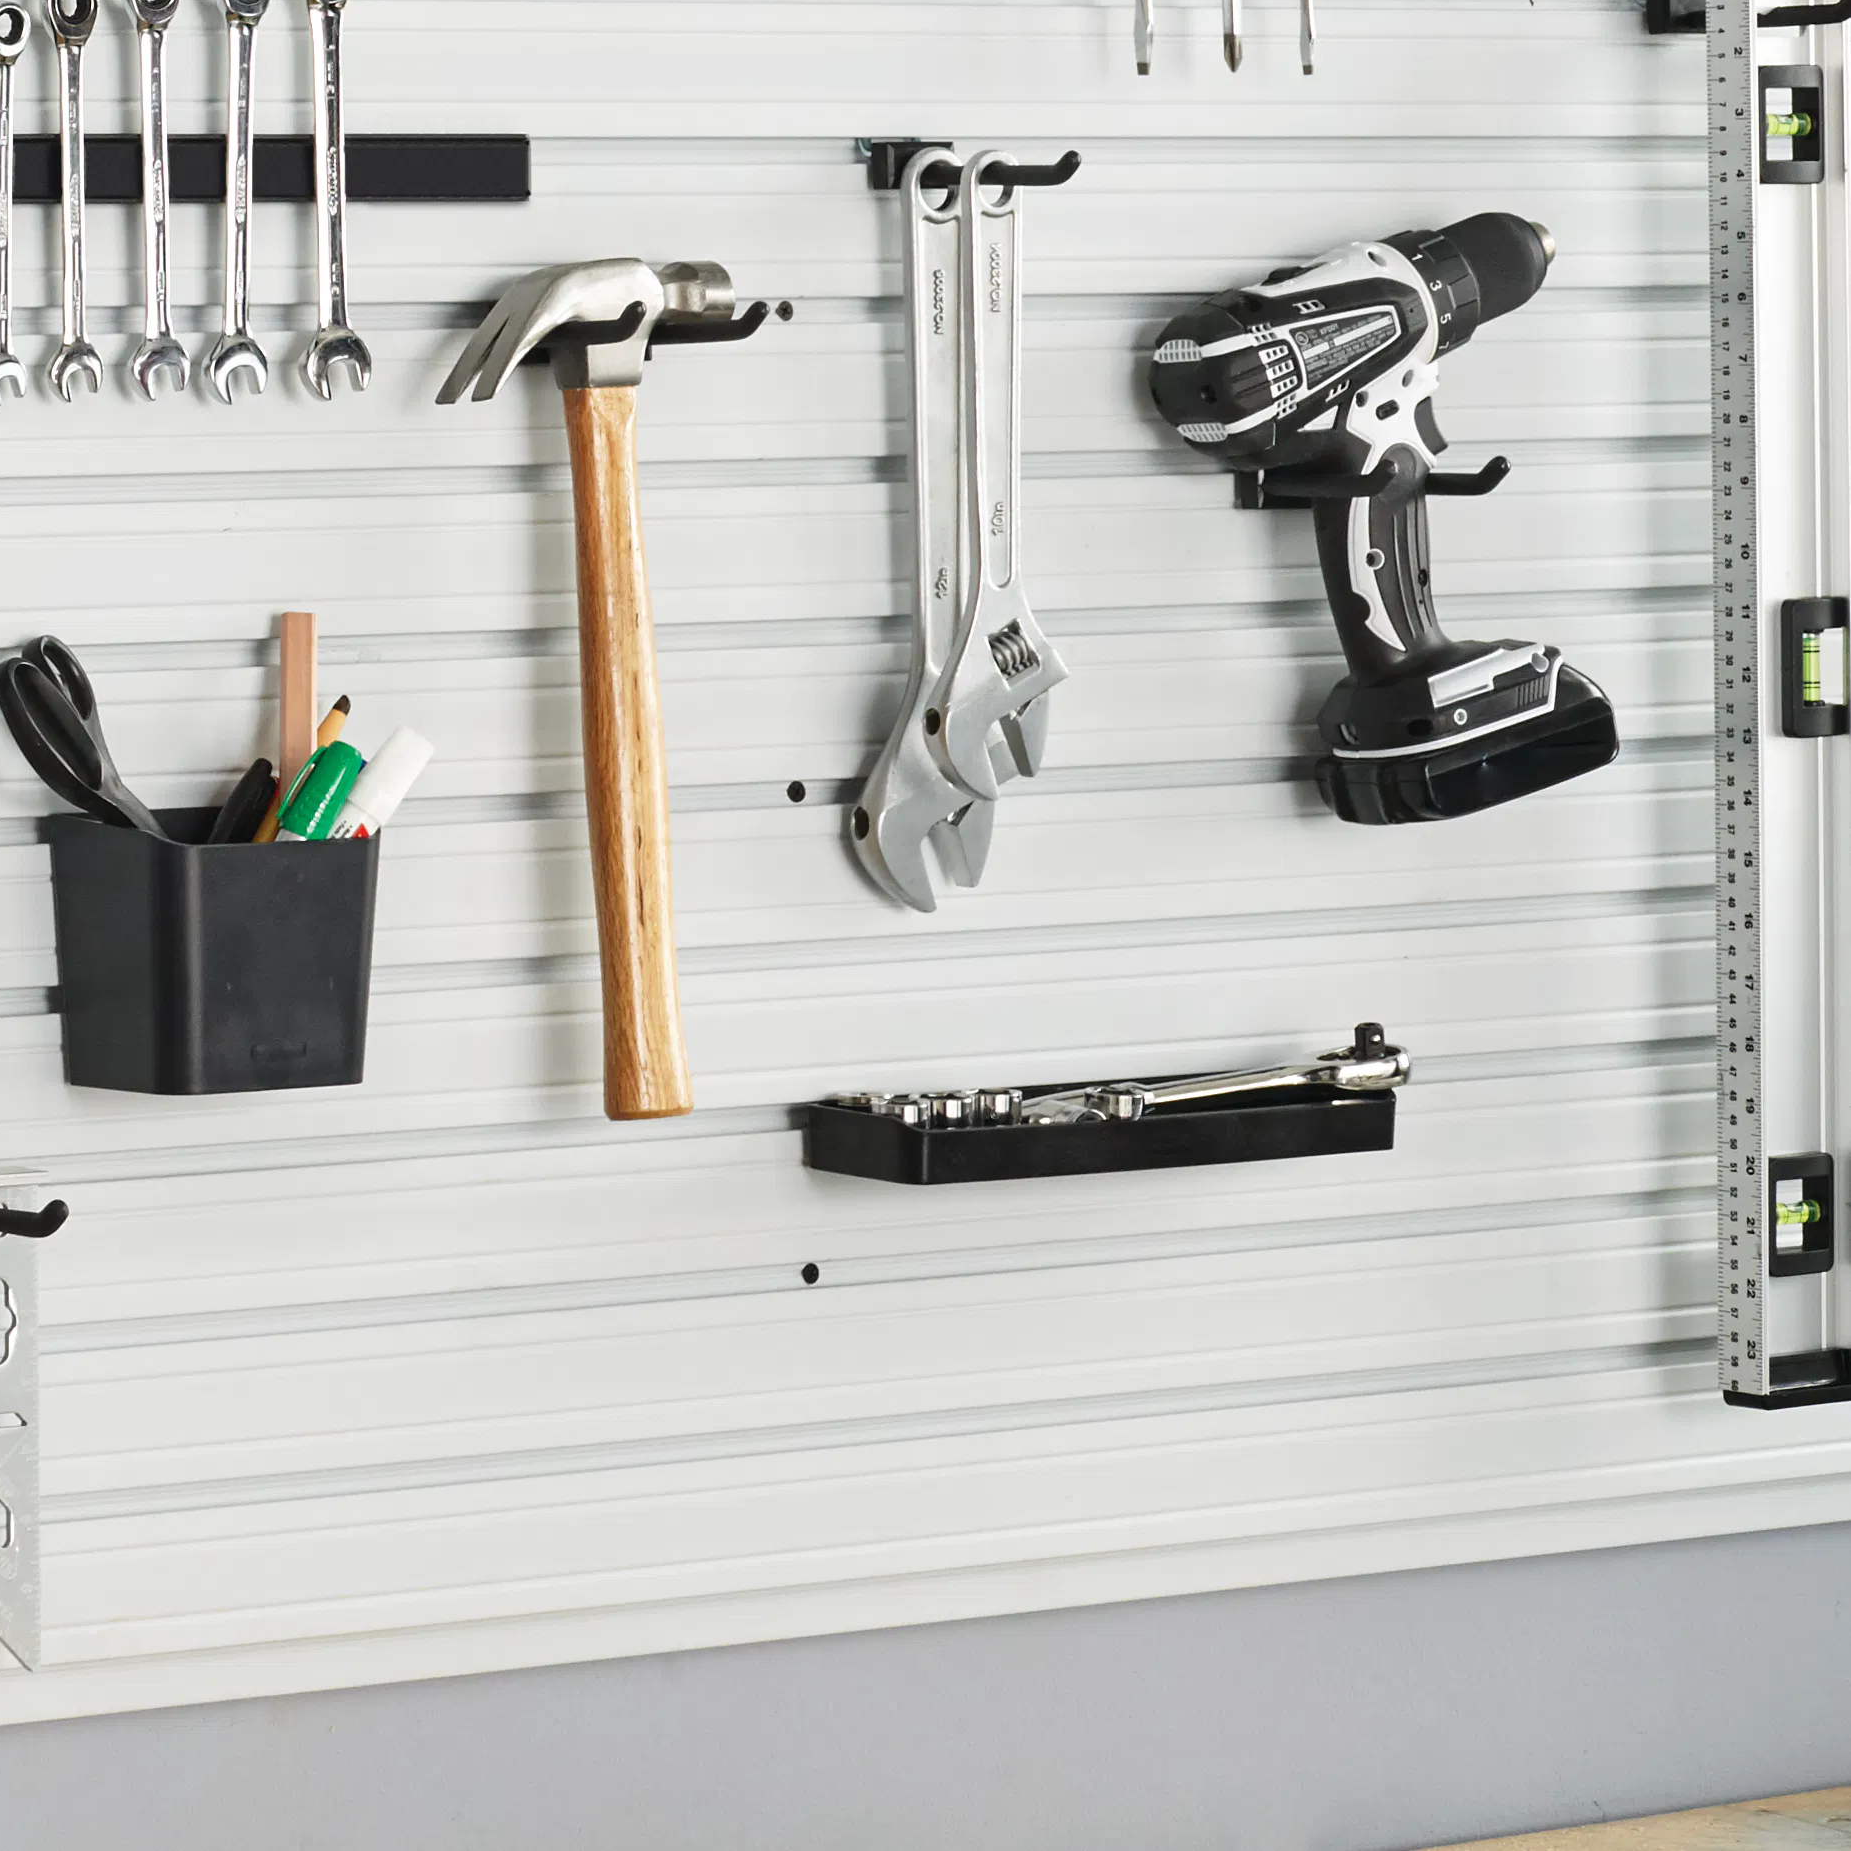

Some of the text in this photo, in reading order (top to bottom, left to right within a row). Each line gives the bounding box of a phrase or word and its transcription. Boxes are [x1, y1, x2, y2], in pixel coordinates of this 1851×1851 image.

[1735, 108, 1744, 117] 3
[1737, 231, 1746, 240] 5
[1412, 253, 1423, 261] 1
[1430, 280, 1442, 291] 3
[1440, 313, 1451, 324] 5
[1738, 354, 1748, 362] 7
[1739, 476, 1749, 485] 9
[1740, 543, 1750, 560] 10
[1741, 604, 1751, 619] 11
[1741, 666, 1751, 683] 12
[1742, 728, 1752, 745] 13
[1743, 789, 1752, 806] 14
[1743, 850, 1753, 868] 15
[1744, 913, 1753, 929] 16
[1745, 974, 1754, 991] 17
[1745, 1035, 1755, 1052] 18
[1746, 1097, 1756, 1114] 19
[1746, 1156, 1756, 1175] 20
[1746, 1217, 1756, 1235] 21
[1747, 1278, 1756, 1299] 22
[1747, 1340, 1757, 1360] 23
